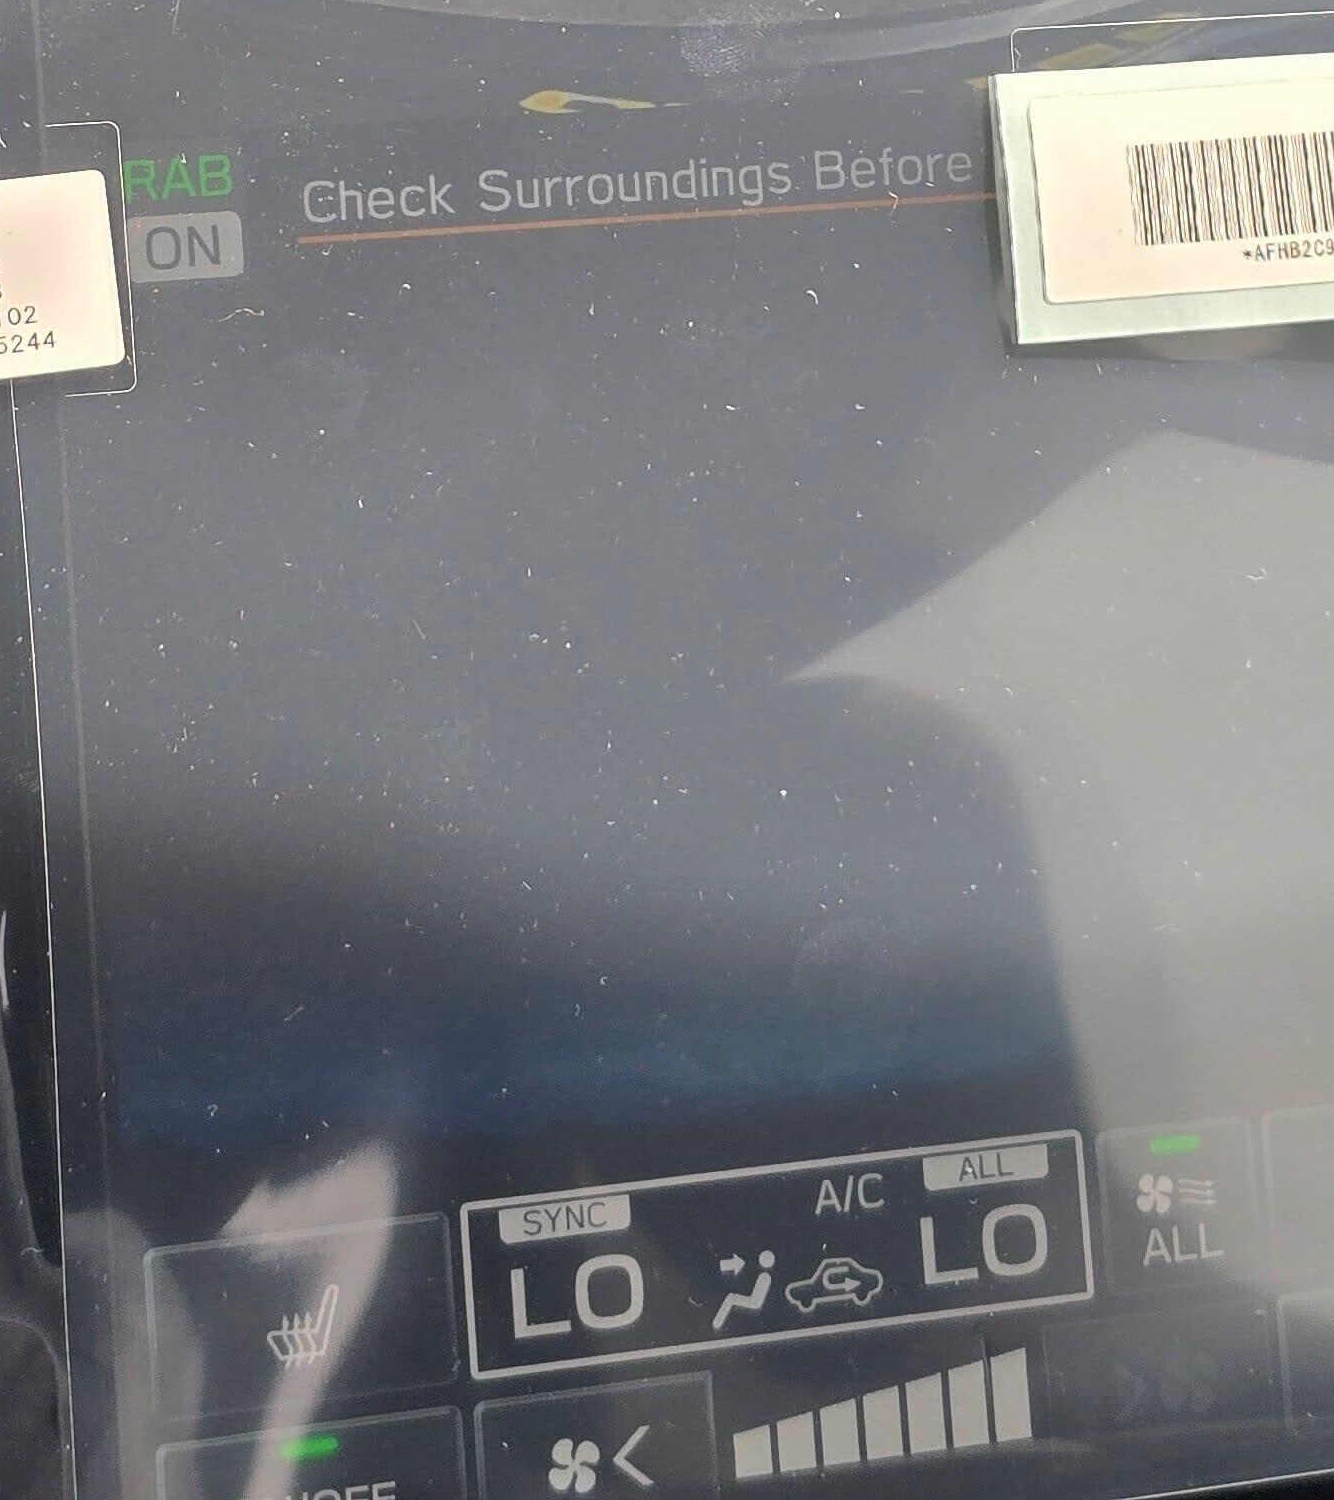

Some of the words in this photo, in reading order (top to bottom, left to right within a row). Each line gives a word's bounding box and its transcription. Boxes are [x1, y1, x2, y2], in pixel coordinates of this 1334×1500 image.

[124, 153, 234, 202] RAB
[303, 173, 456, 224] Check
[479, 155, 793, 208] Surroundings
[815, 145, 974, 193] Before
[145, 223, 221, 271] ON
[958, 1152, 1015, 1183] ALL
[814, 1171, 885, 1216] A/C
[521, 1201, 608, 1236] SYNC
[919, 1202, 1048, 1286] LO
[1142, 1222, 1226, 1267] ALL
[510, 1253, 644, 1339] LO
